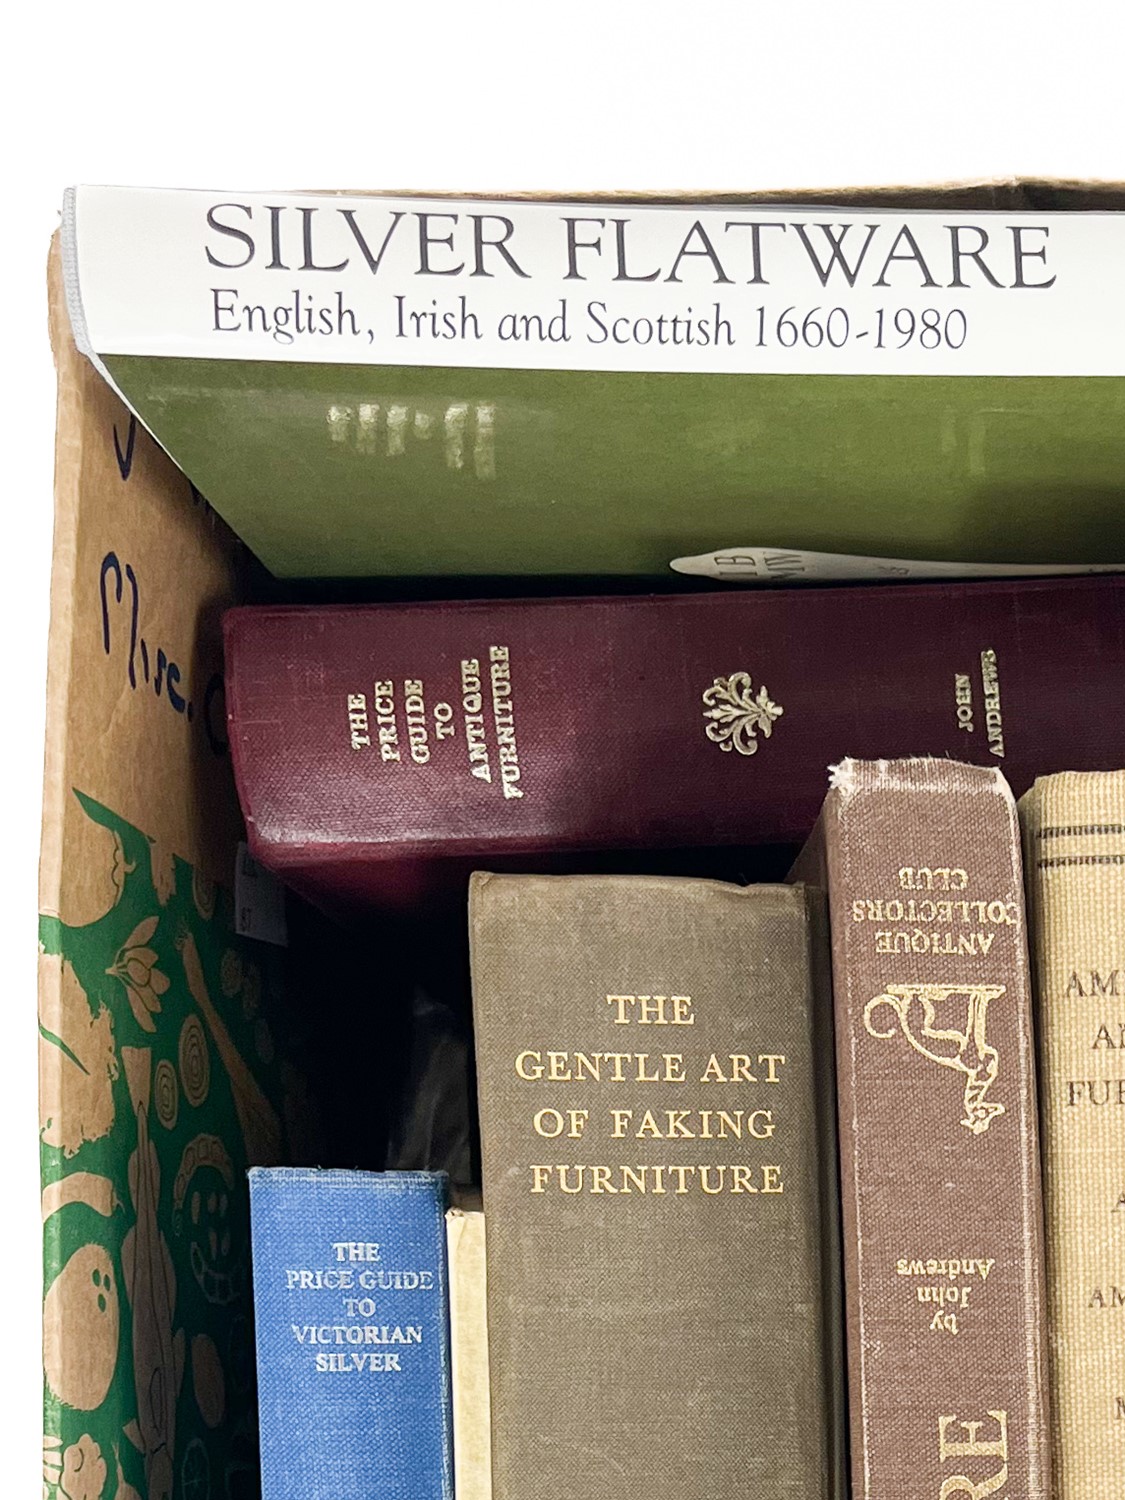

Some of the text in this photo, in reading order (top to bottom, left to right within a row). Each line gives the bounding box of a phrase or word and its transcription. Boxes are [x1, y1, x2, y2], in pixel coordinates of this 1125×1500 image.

[205, 203, 1057, 290] SILVER FLATWARE
[212, 289, 968, 350] English, Irish and Scottish 1660-1980
[955, 673, 974, 732] JOHN
[981, 648, 1005, 758] ANDREWS
[348, 692, 370, 750] THE
[375, 681, 399, 763] PRICE
[405, 680, 430, 763] GUIDE
[434, 702, 455, 740] TO
[461, 658, 492, 783] ANTIQUE
[490, 645, 523, 800] FURNITURE
[898, 867, 968, 892] CLUB
[874, 931, 995, 956] ANTIQUE
[607, 995, 695, 1026] THE
[515, 1051, 785, 1083] GENTLE ART
[533, 1109, 775, 1139] OF FAKING
[530, 1165, 784, 1194] FURNITURE
[333, 1242, 380, 1262] THE
[286, 1269, 433, 1290] PRICE GUIDE
[896, 1257, 995, 1280] Andrews
[343, 1298, 375, 1317] TO
[916, 1286, 973, 1308] John
[292, 1324, 423, 1345] VICTORIAN
[930, 1311, 957, 1335] by
[316, 1352, 402, 1372] SILVER
